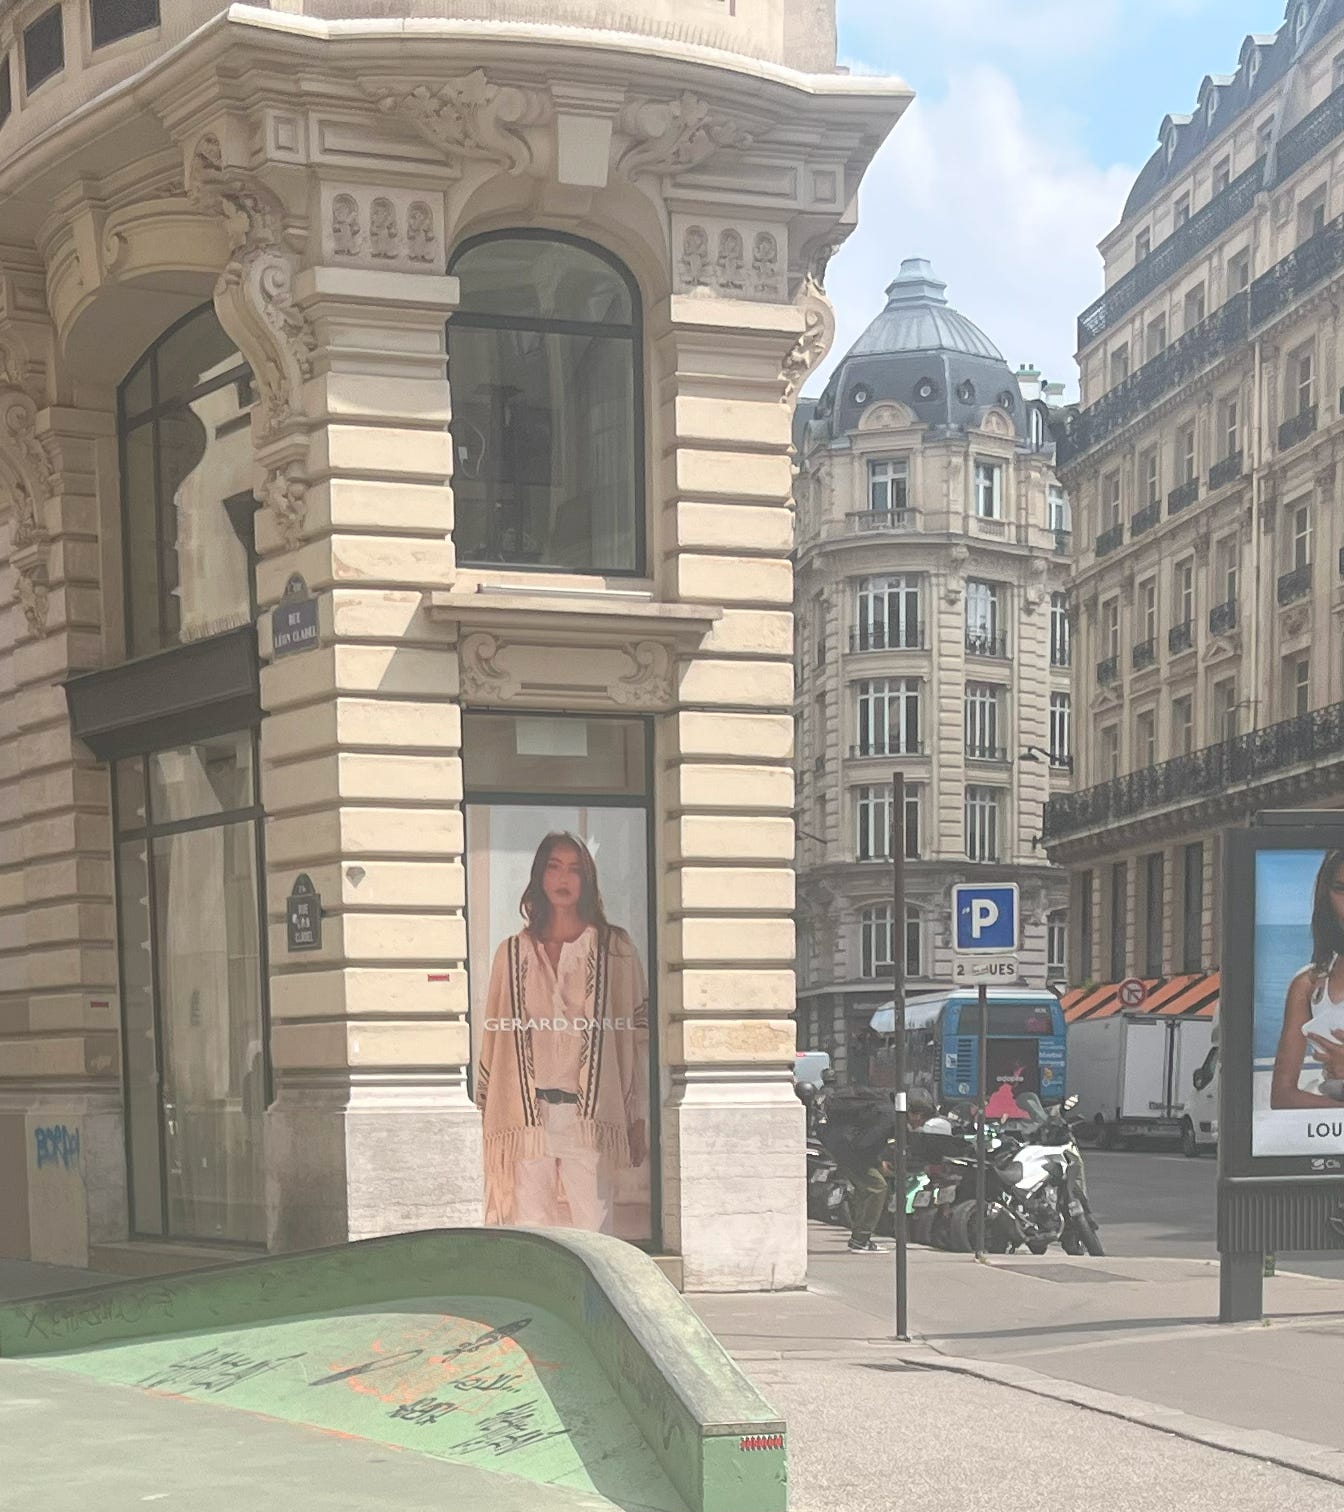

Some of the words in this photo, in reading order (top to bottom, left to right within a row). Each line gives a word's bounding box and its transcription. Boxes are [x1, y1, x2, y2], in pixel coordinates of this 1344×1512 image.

[971, 898, 999, 939] P
[957, 963, 965, 976] 2
[483, 1017, 568, 1032] GERARD
[573, 1017, 637, 1031] DAREL
